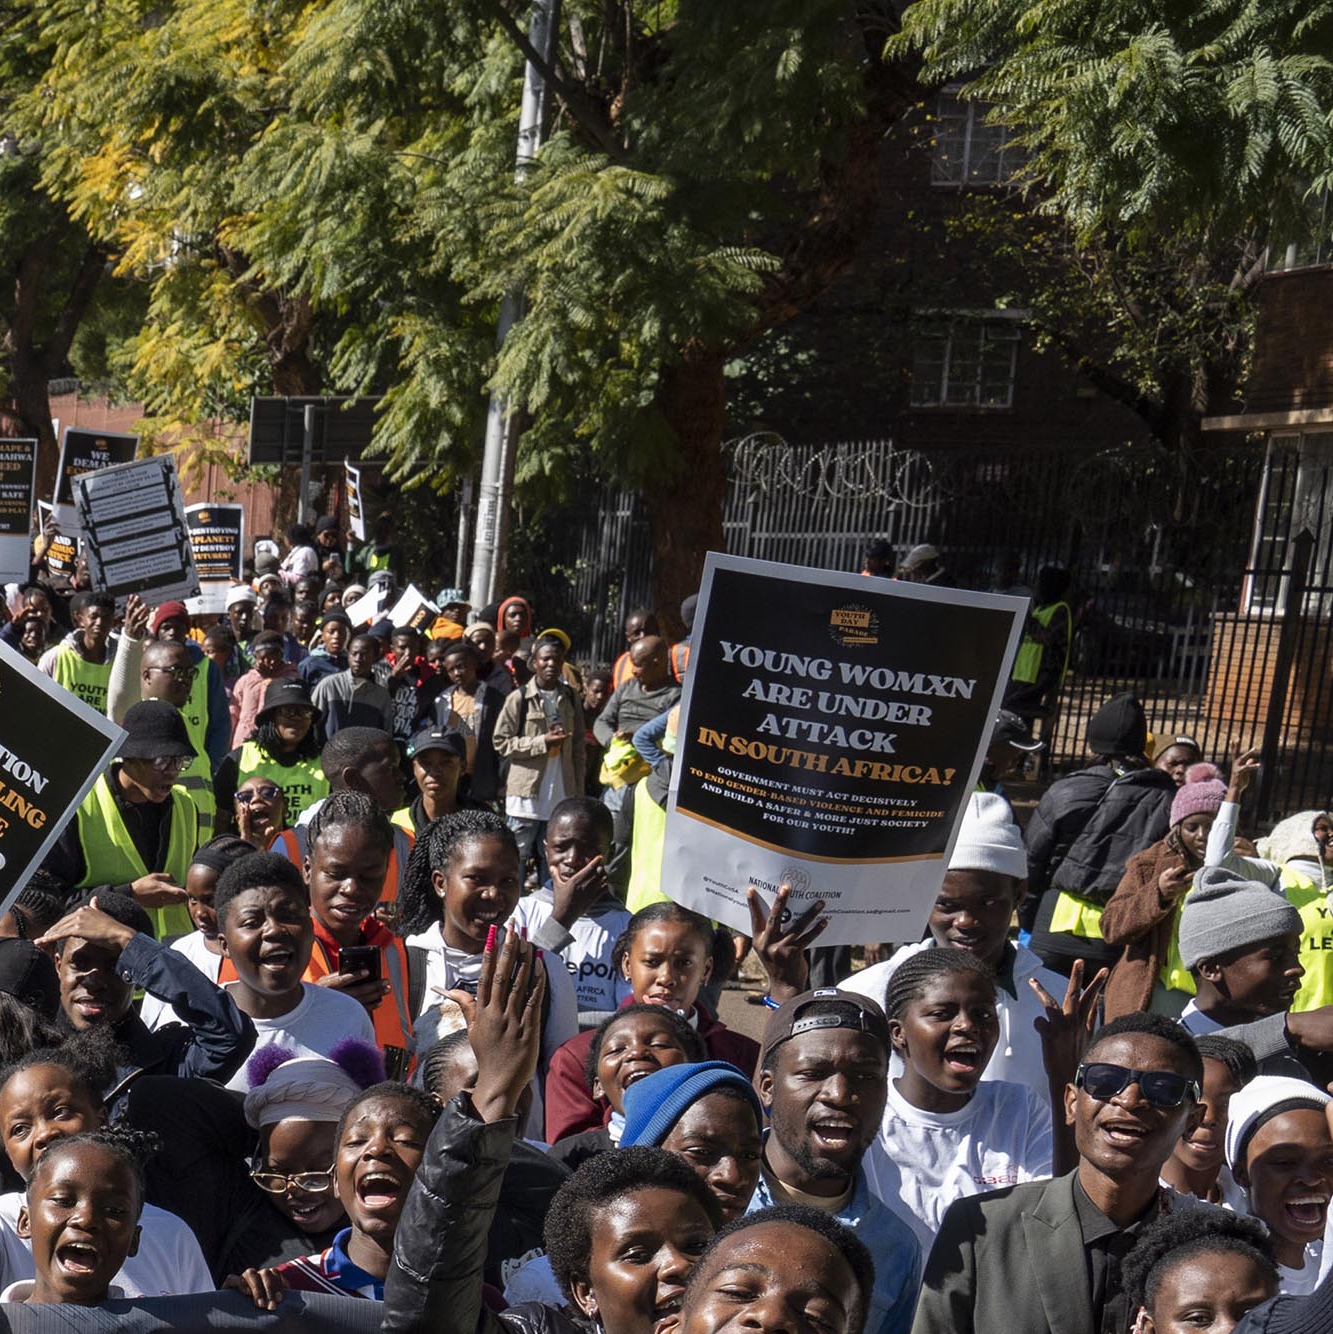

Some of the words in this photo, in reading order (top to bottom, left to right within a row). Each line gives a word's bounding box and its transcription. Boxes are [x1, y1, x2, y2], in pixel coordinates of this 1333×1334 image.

[90, 451, 110, 460] WE
[835, 611, 866, 620] YOUTH
[840, 618, 859, 626] DAY
[719, 640, 833, 680] YOUNG
[839, 662, 977, 699] WOMXN
[742, 679, 814, 707] ARE
[817, 695, 933, 727] UNDER
[756, 714, 898, 754] ATTACK
[697, 726, 727, 751] IN
[729, 736, 832, 774] SOUTH
[831, 757, 957, 786] AFRICA!
[689, 766, 703, 778] TO
[704, 771, 724, 785] END
[725, 778, 807, 807] GENDER-BASED
[808, 798, 862, 815] VIOLENCE
[863, 806, 889, 817] AND
[891, 808, 946, 819] FEMICIDE
[701, 782, 723, 796] AND
[723, 787, 755, 805] BUILD
[754, 798, 764, 809] A
[765, 799, 802, 818] SAFER
[803, 809, 812, 818] &
[814, 810, 847, 825] MORE
[848, 815, 879, 828] JUST
[880, 819, 930, 830] SOCIETY
[717, 766, 790, 791] GOVERNMENT
[791, 784, 823, 799] MUST
[825, 789, 849, 801] ACT
[851, 793, 918, 808] DECISIVELY
[762, 811, 784, 826] FOR
[786, 815, 810, 831] OUR
[812, 822, 856, 837] YOUTH!
[748, 876, 780, 894] NATIONAL
[805, 890, 843, 900] COALITION
[577, 985, 606, 996] AFRICA
